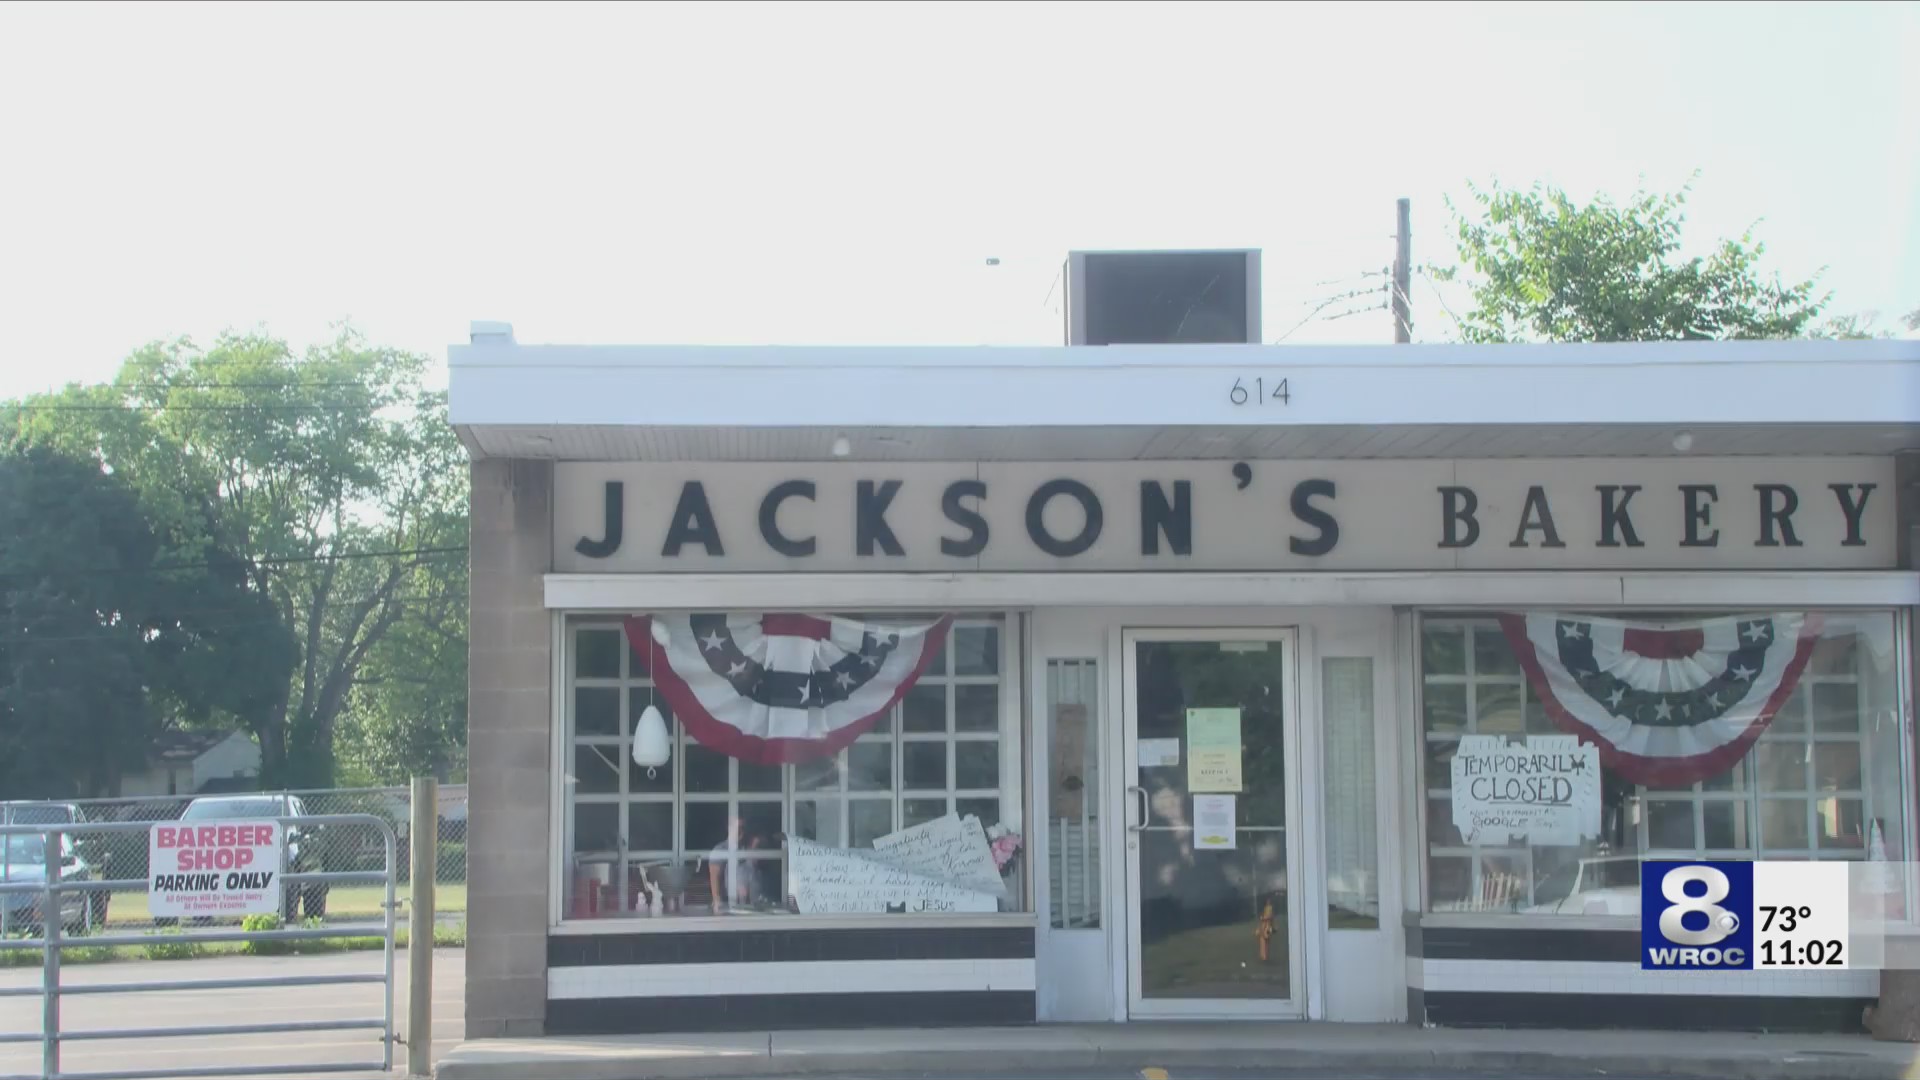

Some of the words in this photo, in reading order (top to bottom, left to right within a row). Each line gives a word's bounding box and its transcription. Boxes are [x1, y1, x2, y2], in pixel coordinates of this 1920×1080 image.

[1230, 377, 1291, 405] 614
[575, 461, 1340, 558] JACKSON'S
[1437, 483, 1878, 549] BAKERY
[1459, 754, 1587, 776] TEMPORARILY
[1471, 776, 1573, 803] CLOSED
[157, 825, 274, 848] BARBER
[177, 848, 254, 871] SHOP
[154, 873, 220, 891] PARKING
[226, 872, 273, 890] ONLY
